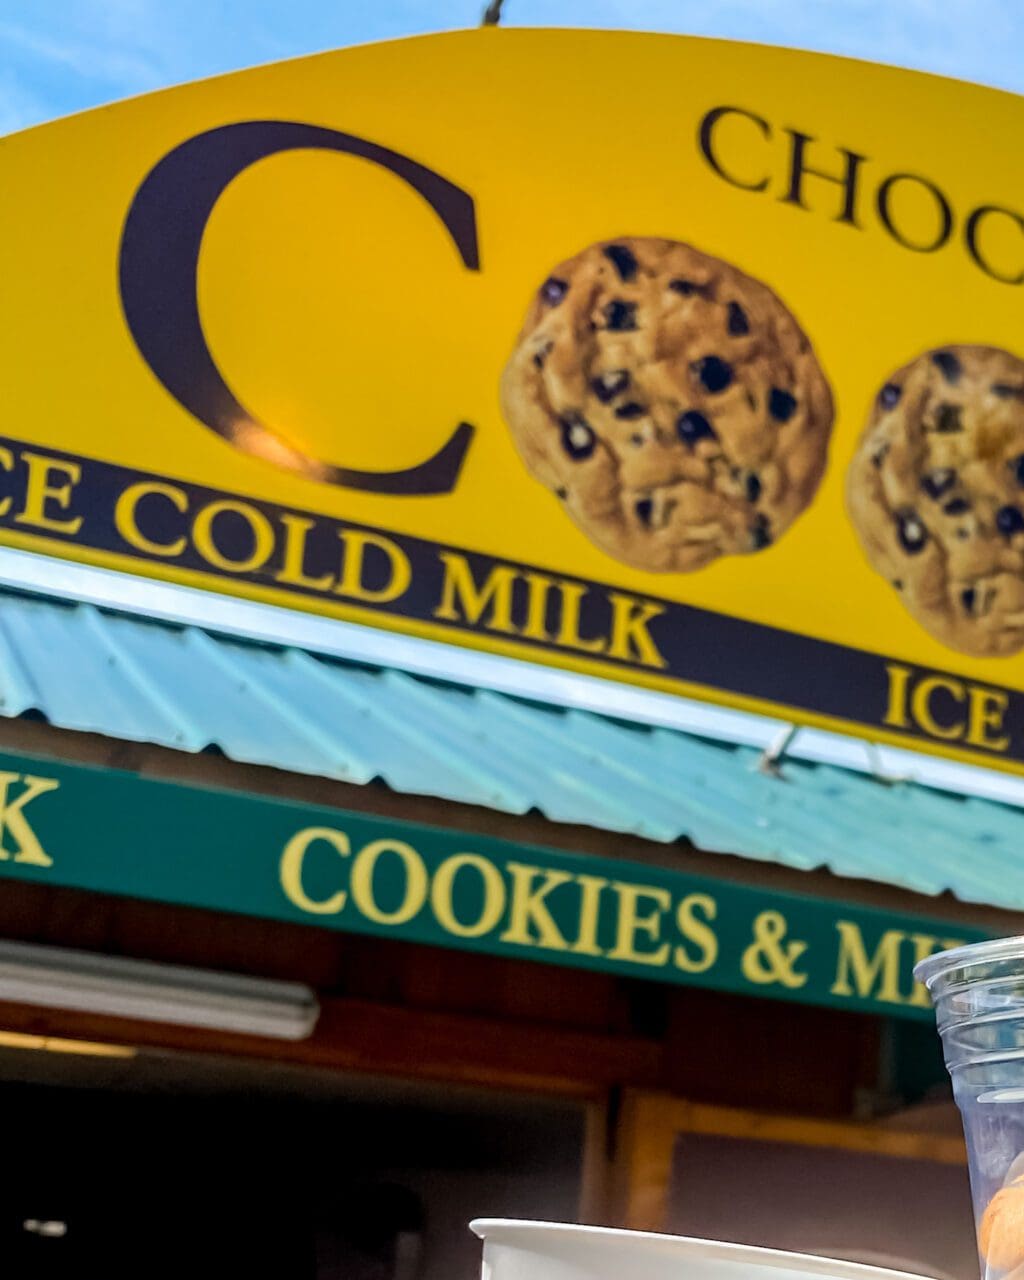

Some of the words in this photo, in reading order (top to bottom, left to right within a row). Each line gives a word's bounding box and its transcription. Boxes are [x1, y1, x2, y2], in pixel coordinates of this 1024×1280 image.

[114, 480, 411, 604] COLD
[435, 552, 669, 669] MILK
[883, 664, 1009, 751] ICE
[279, 826, 718, 973] COOKIES
[741, 910, 808, 988] &
[831, 920, 968, 1008] MI
